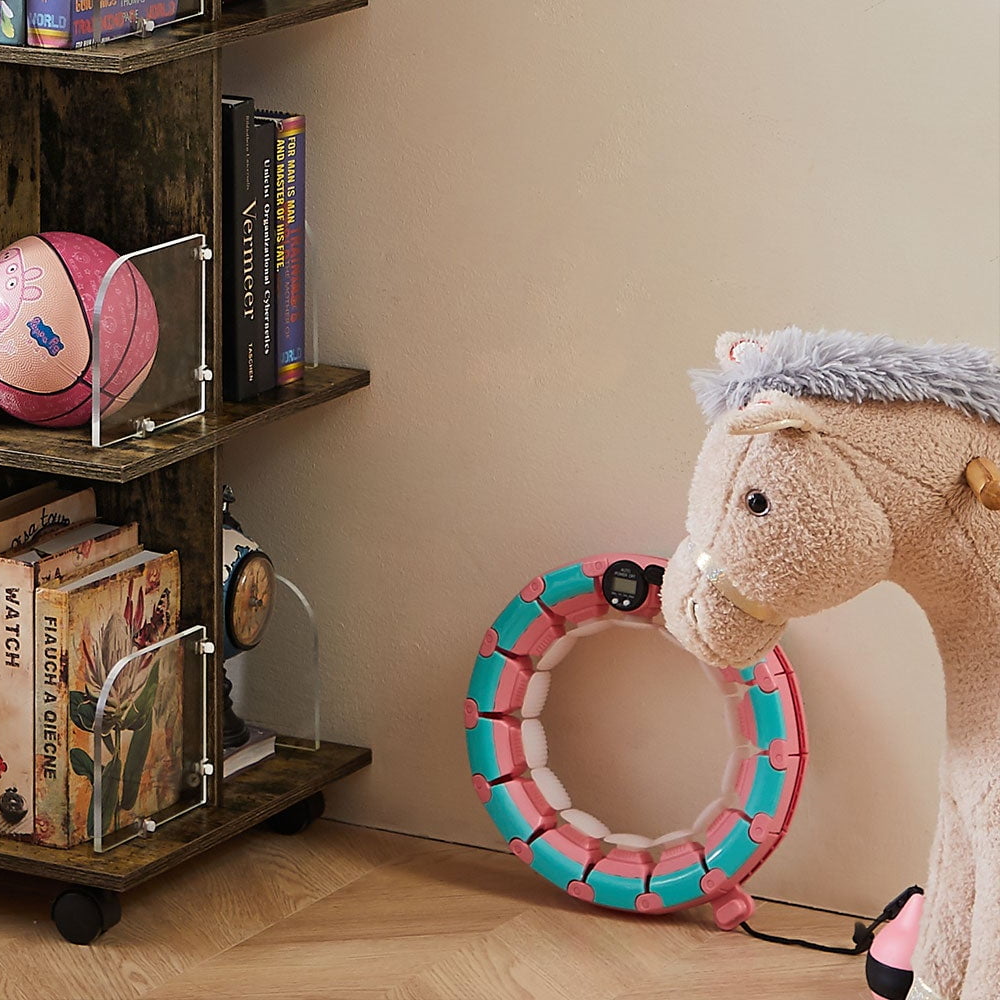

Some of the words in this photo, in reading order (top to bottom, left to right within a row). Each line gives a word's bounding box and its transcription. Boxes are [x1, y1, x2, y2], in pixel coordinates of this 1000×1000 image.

[276, 139, 285, 161] AND
[287, 136, 296, 157] FOR
[287, 159, 296, 184] MAN
[276, 163, 285, 206] MASTER
[287, 186, 295, 198] IS
[276, 208, 284, 222] OF
[286, 200, 295, 224] MAN
[263, 203, 271, 286] Organizational
[276, 224, 284, 243] HIS
[242, 197, 257, 320] Vermeer
[276, 245, 284, 273] FATE.
[263, 289, 271, 355] Cybernetics
[5, 587, 20, 668] WATCH
[44, 616, 58, 685] FIAUCH
[44, 691, 57, 704] A
